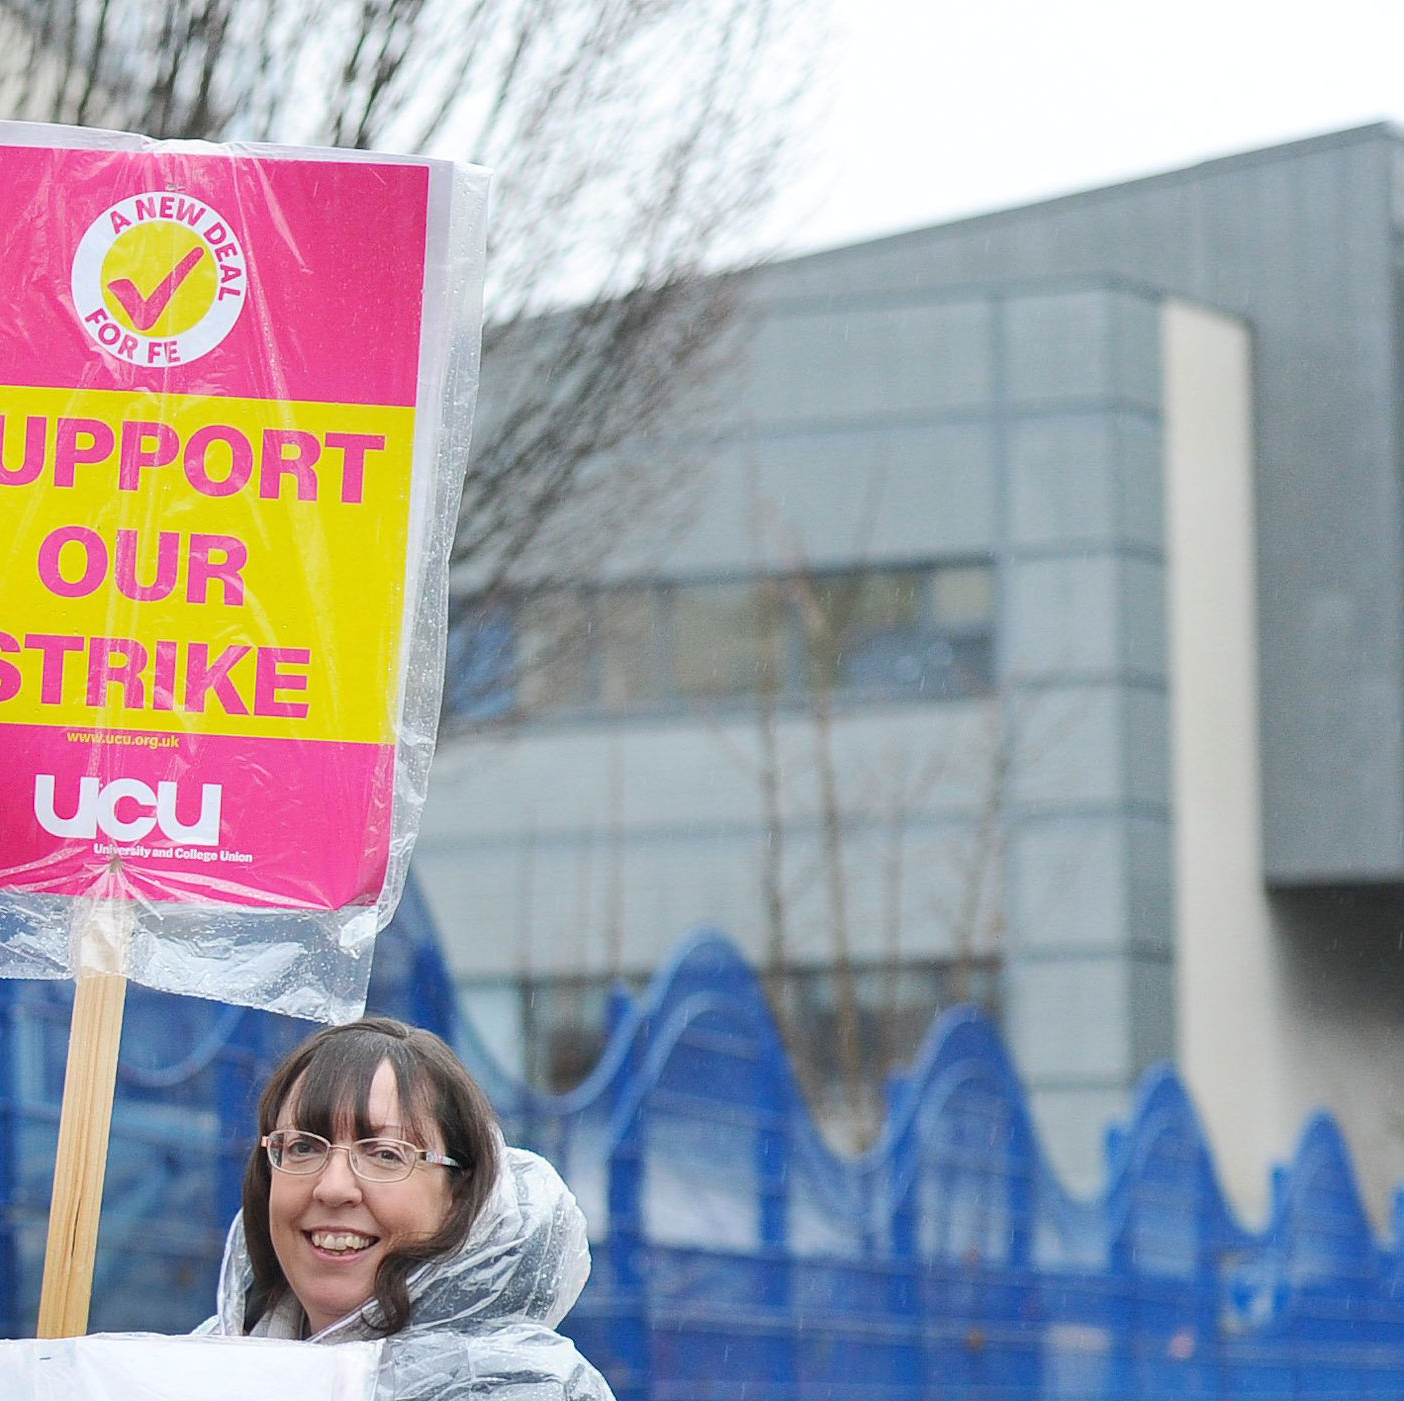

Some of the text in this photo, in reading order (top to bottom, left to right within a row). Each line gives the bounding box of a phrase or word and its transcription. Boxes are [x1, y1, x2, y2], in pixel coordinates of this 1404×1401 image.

[110, 196, 242, 301] A NEW DEAL
[85, 308, 181, 363] FOR FE
[36, 526, 247, 606] OUR
[67, 731, 180, 749] www.ucu.org.uk
[94, 843, 253, 863] University and College Union
